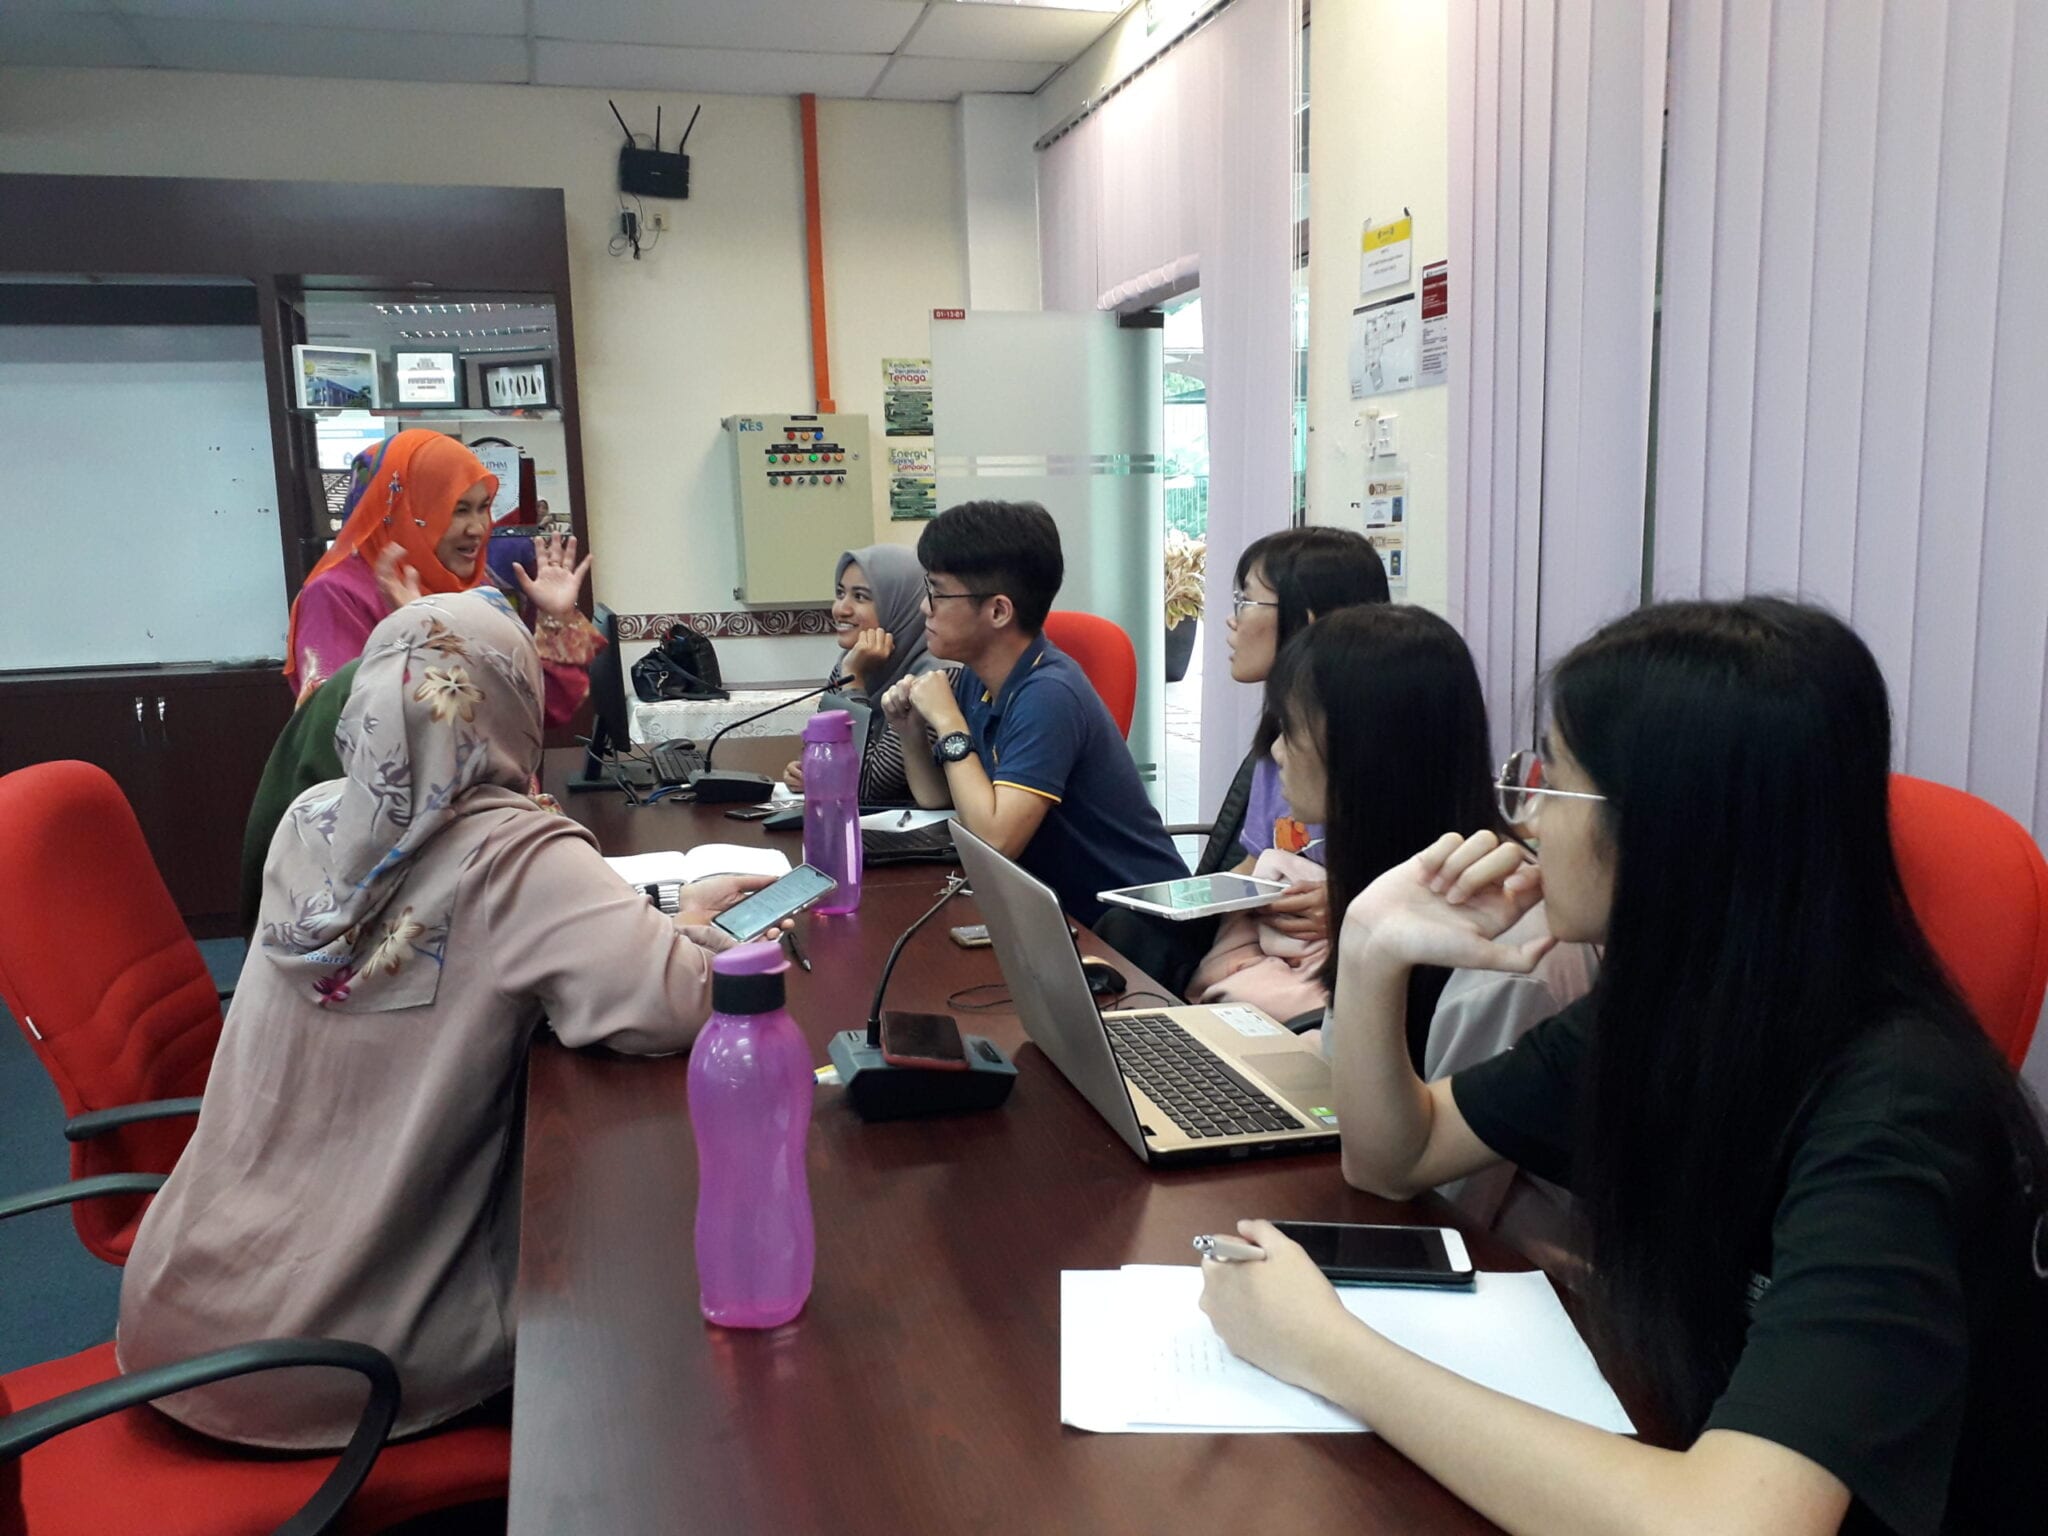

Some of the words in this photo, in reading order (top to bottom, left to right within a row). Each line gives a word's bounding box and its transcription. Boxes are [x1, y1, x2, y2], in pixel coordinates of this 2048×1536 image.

[889, 372, 927, 384] Tenaga
[740, 422, 763, 432] KES
[891, 449, 927, 461] Energy
